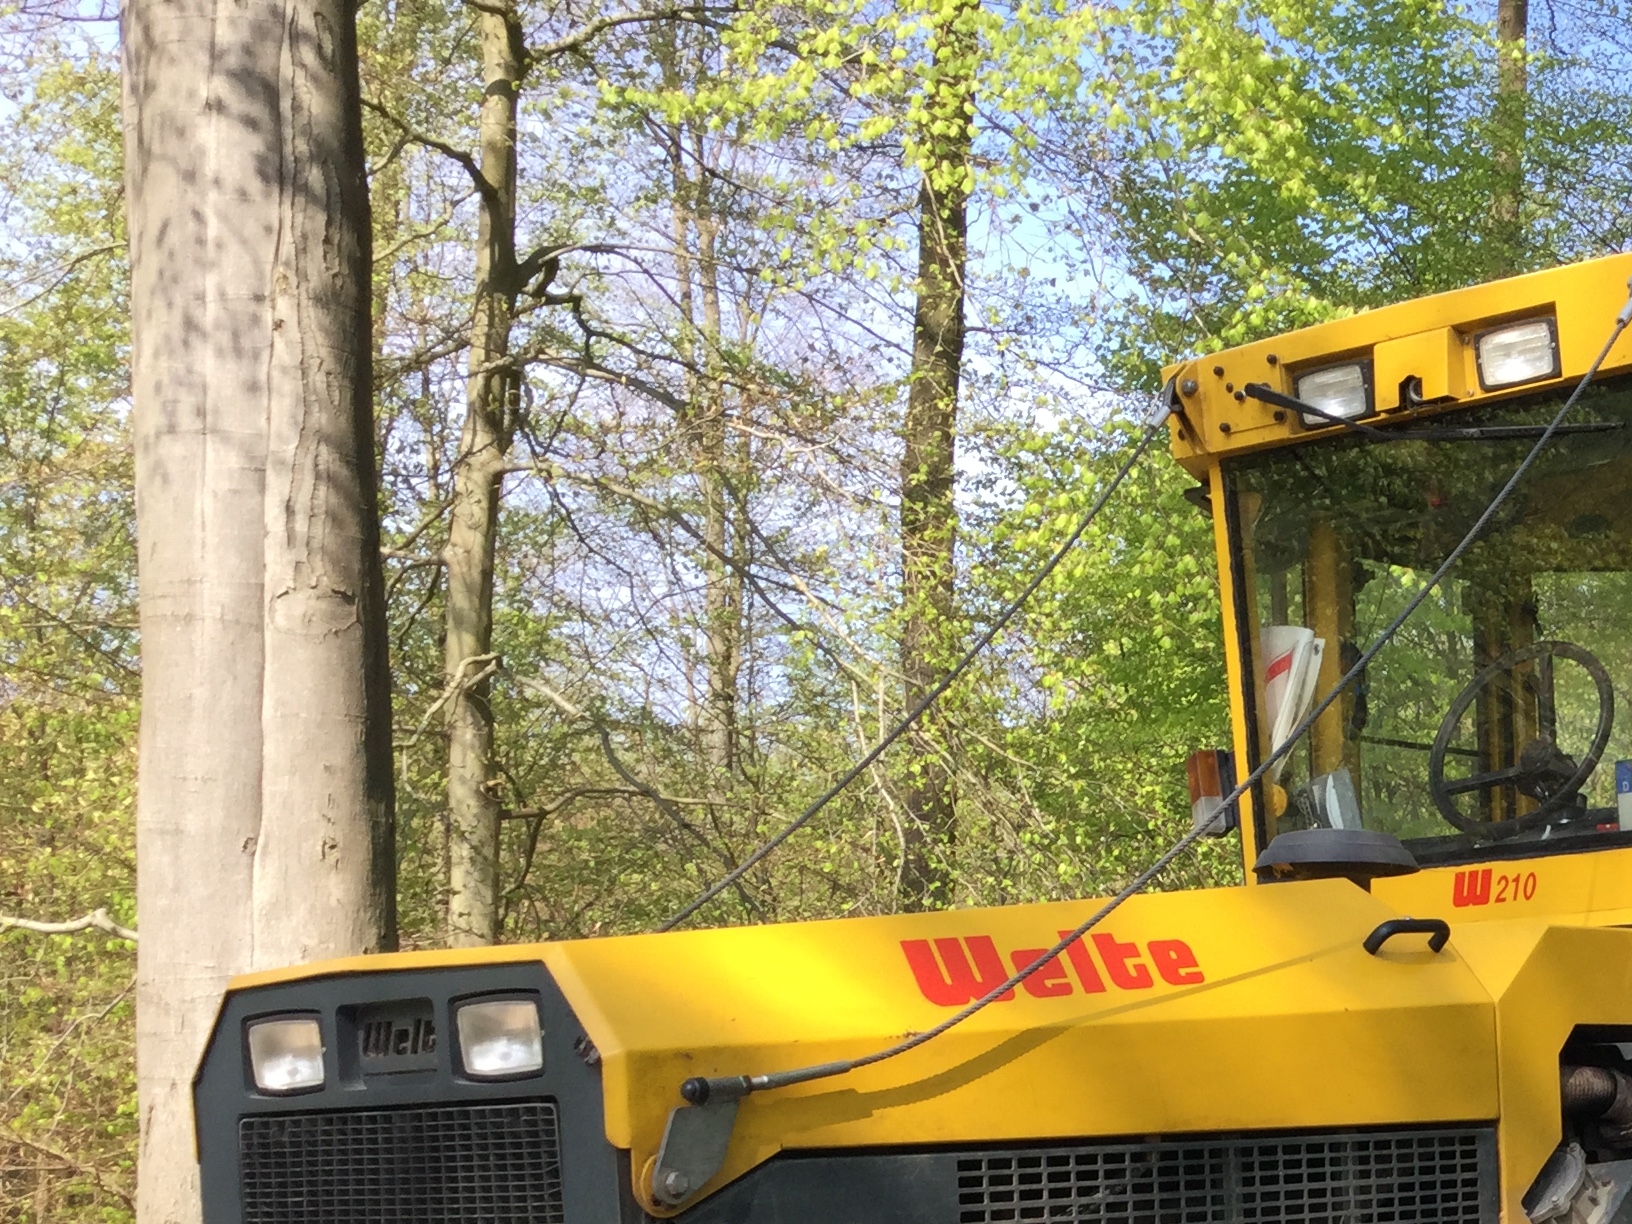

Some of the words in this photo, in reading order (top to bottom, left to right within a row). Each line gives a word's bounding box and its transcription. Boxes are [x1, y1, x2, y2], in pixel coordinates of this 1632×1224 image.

[1622, 780, 1630, 791] D
[1453, 868, 1492, 908] W
[1495, 871, 1537, 903] 210
[900, 930, 1206, 1007] Welte
[361, 1017, 437, 1058] Welt
